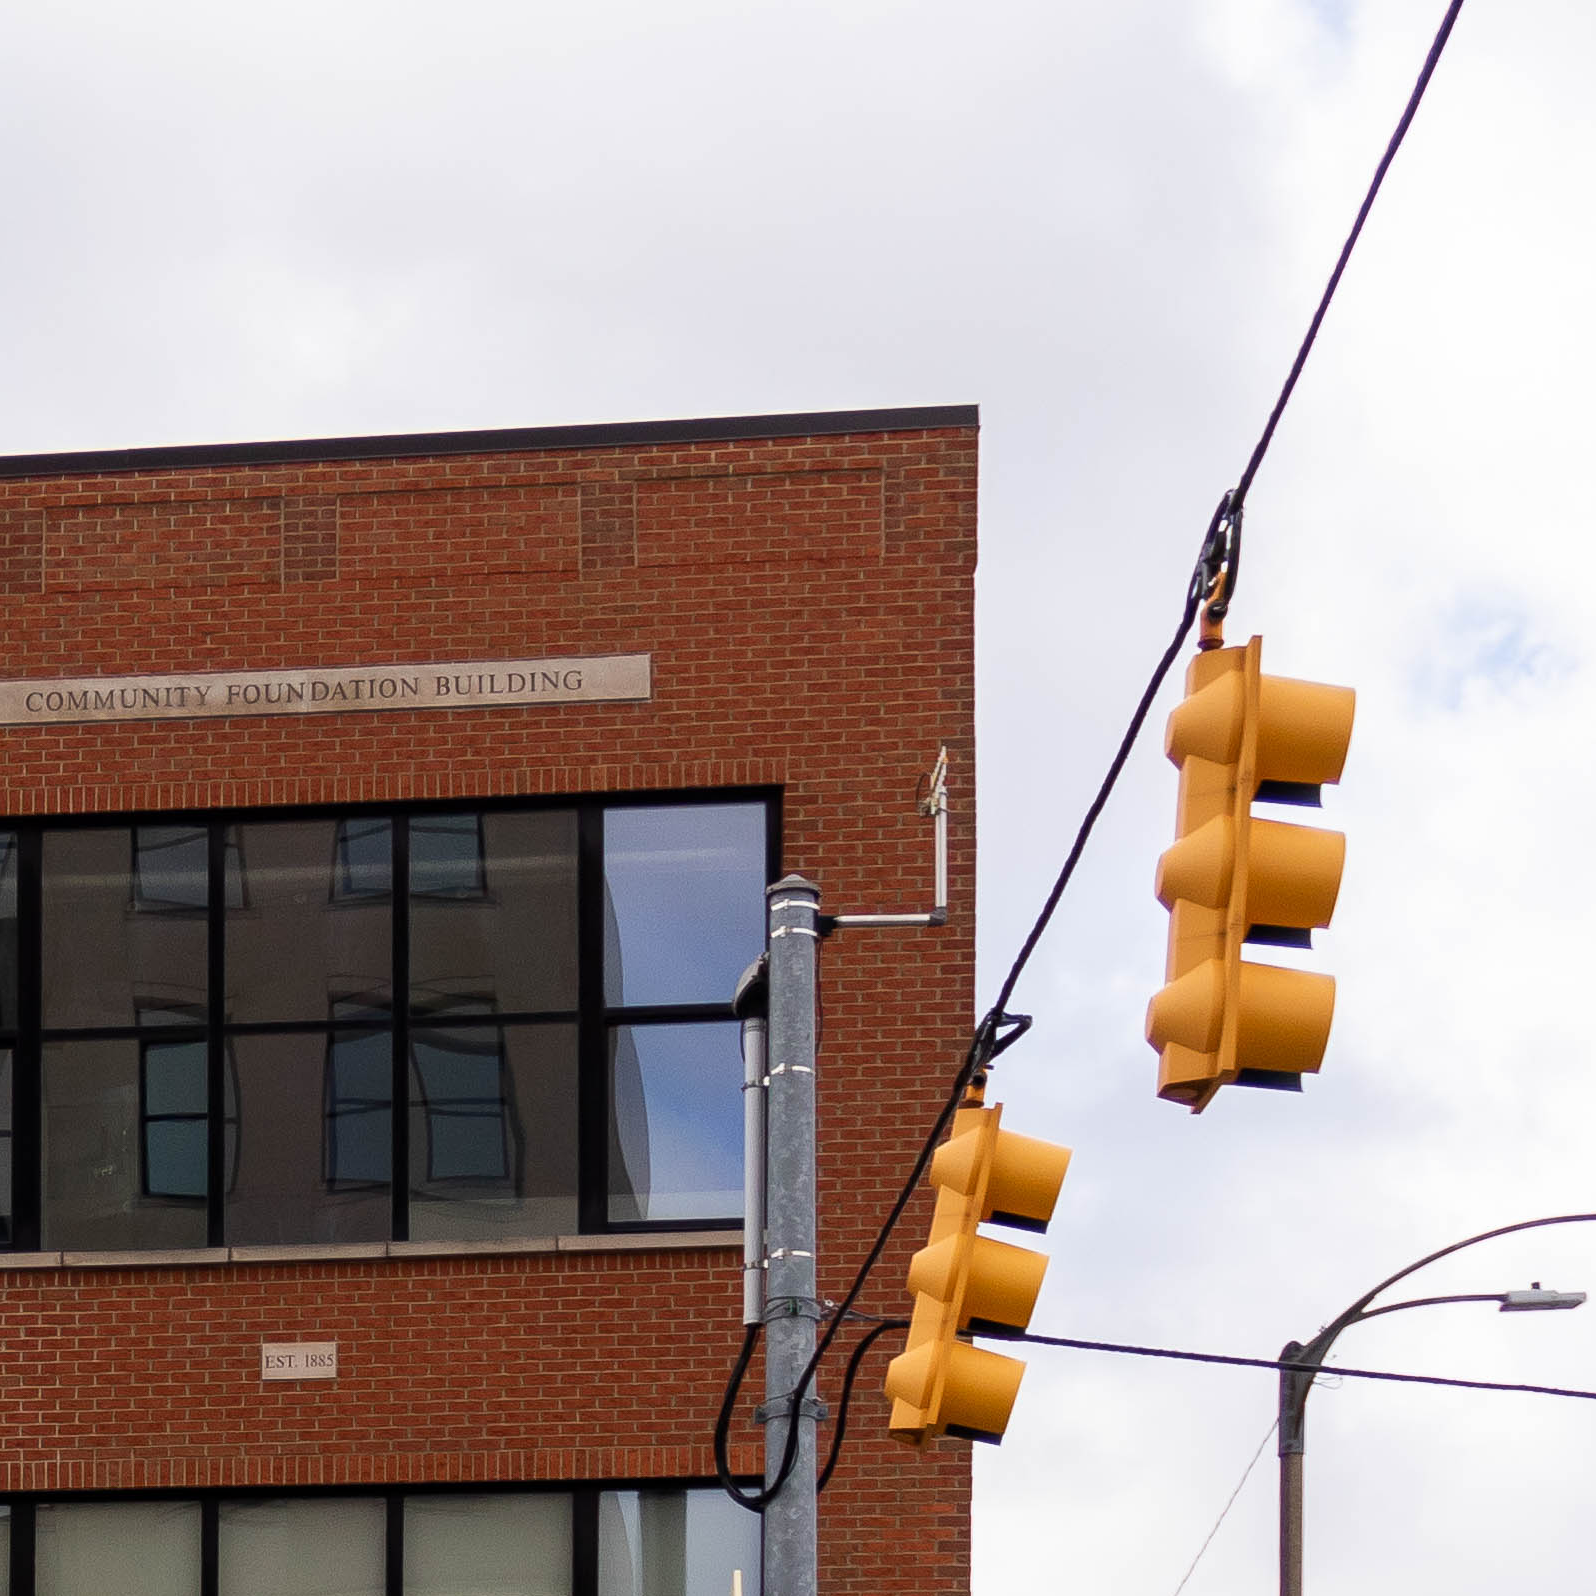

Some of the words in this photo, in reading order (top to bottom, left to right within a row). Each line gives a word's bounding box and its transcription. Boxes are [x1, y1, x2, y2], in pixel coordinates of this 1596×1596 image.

[24, 684, 212, 713] COMMUNITY
[225, 675, 420, 706] FOUNDATION
[435, 669, 585, 698] BUILDING
[265, 1354, 298, 1369] EST.
[305, 1353, 335, 1368] 1885
